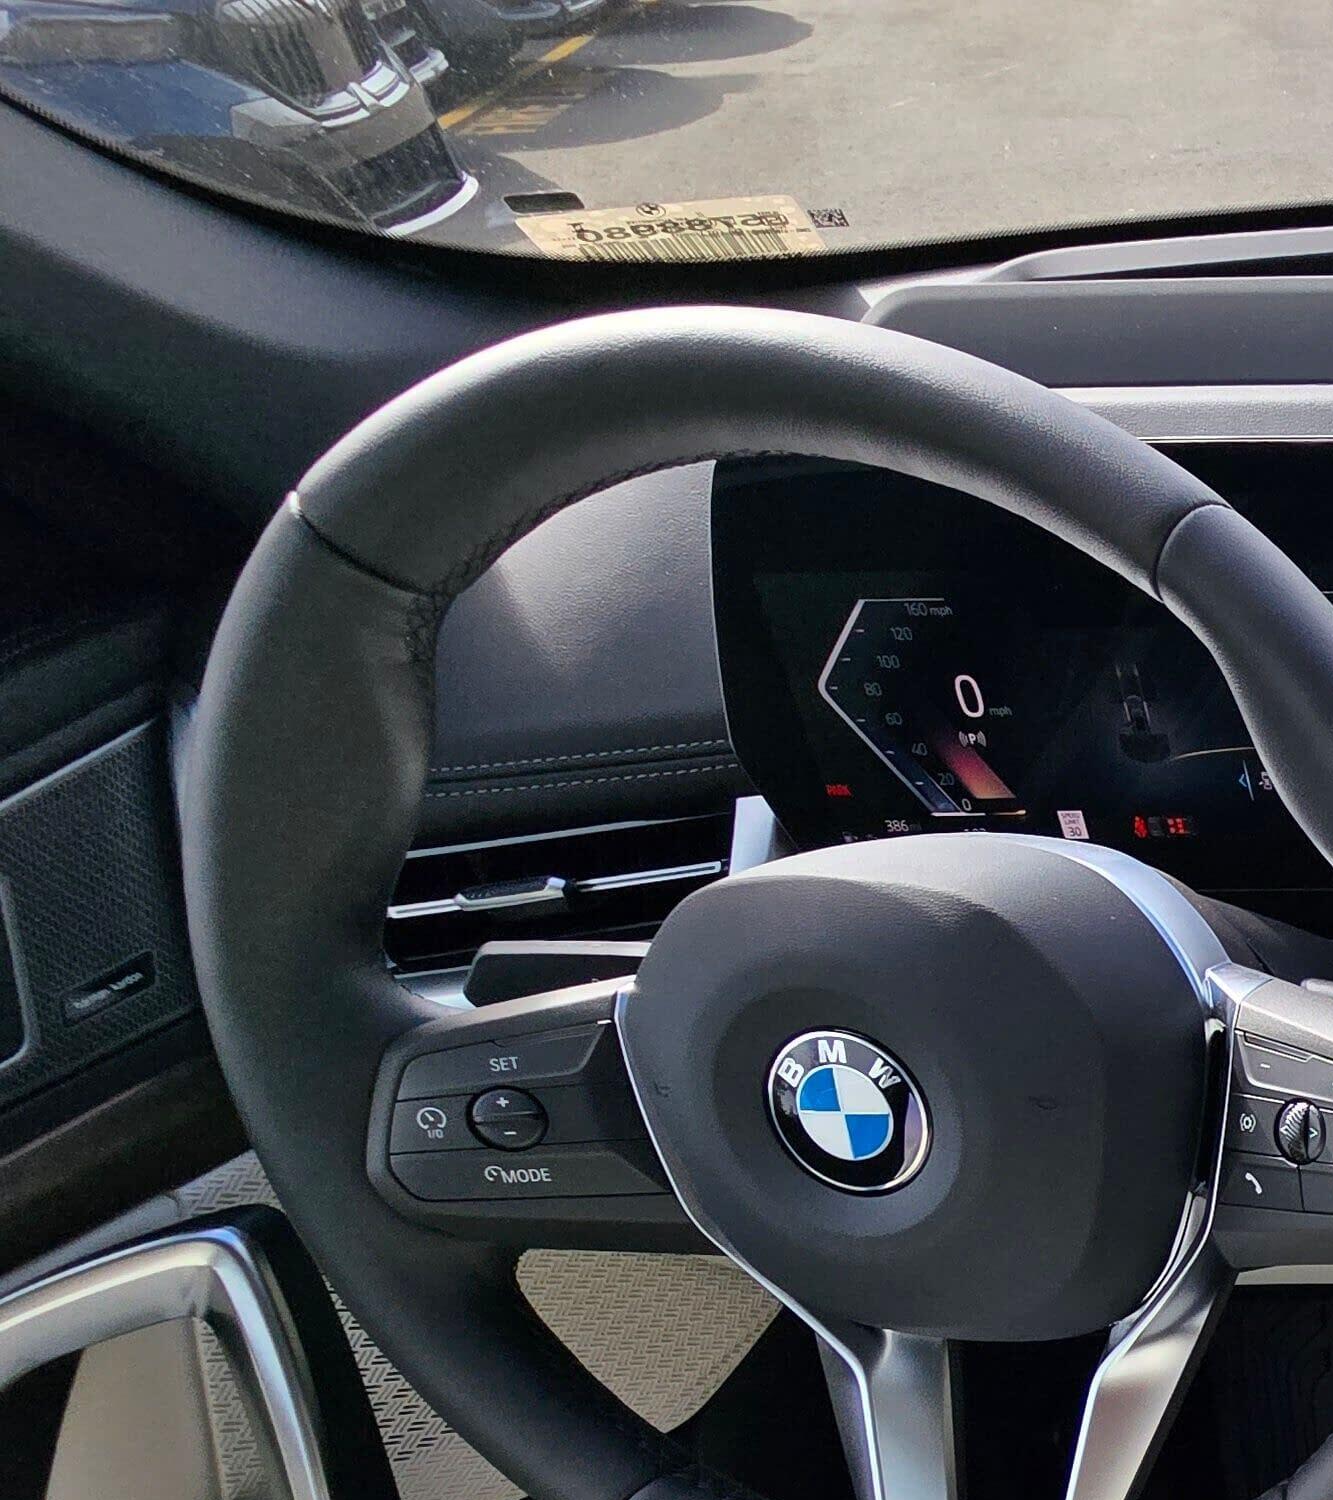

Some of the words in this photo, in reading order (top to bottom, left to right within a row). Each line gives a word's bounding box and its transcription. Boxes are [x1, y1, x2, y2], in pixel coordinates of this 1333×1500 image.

[903, 602, 928, 617] 160
[890, 627, 914, 641] 120
[876, 654, 901, 669] 100
[864, 682, 883, 697] 80
[954, 674, 985, 718] 0
[885, 711, 903, 726] 60
[911, 742, 928, 757] 40
[937, 772, 955, 787] 20
[961, 798, 972, 811] 0
[884, 819, 910, 832] 386
[1068, 826, 1083, 838] 30
[488, 1056, 519, 1072] SET
[501, 1167, 552, 1184] MODE
